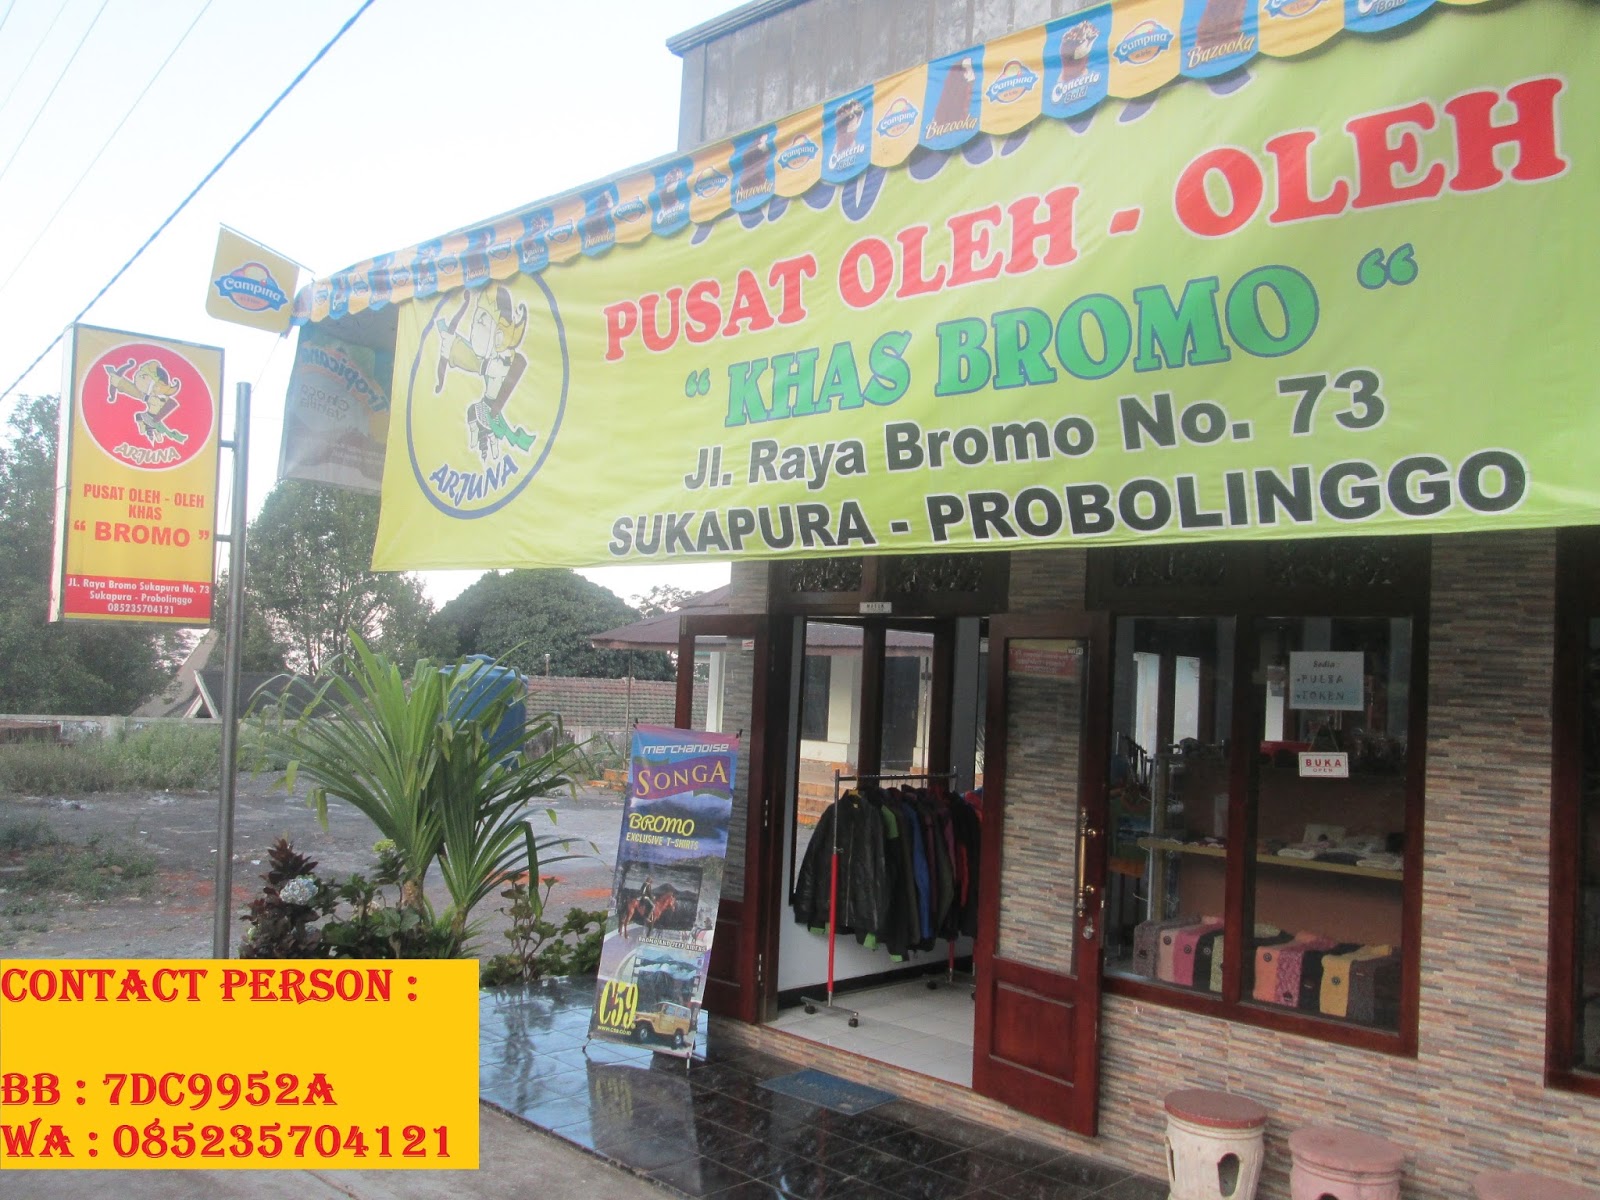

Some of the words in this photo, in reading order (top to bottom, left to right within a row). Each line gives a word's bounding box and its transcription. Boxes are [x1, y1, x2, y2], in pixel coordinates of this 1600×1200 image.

[1119, 33, 1168, 55] Campina
[1186, 32, 1256, 69] Bazooka
[990, 76, 1033, 95] Campina
[1051, 72, 1100, 102] Concerto
[879, 111, 917, 130] Campina
[924, 115, 979, 140] Bazooka
[603, 253, 817, 361] PUSAT
[838, 186, 1079, 309] OLEH
[1175, 77, 1568, 237] OLEH
[222, 277, 282, 302] Campina
[724, 330, 913, 427] KHAS
[934, 264, 1320, 397] BROMO
[684, 444, 733, 490] Jl.
[748, 438, 867, 490] Raya
[884, 416, 1095, 472] Bromo
[1119, 392, 1252, 450] No.
[1278, 369, 1385, 434] 73
[113, 441, 182, 465] ARJUNA
[428, 453, 519, 507] ARJUNA
[83, 483, 125, 501] PUSAT
[128, 488, 161, 504] OLEH
[174, 492, 205, 508] OLEH
[608, 499, 878, 557] SUKAPURA
[926, 449, 1527, 542] PROBOLINGGO
[128, 504, 162, 520] KHAS
[94, 521, 191, 547] BROMO
[83, 579, 106, 590] Raya
[109, 580, 137, 590] Bromo
[140, 581, 180, 593] Sukapura
[182, 583, 197, 593] No.
[199, 585, 210, 594] 73
[90, 590, 132, 602] Sukapura
[141, 593, 193, 606] Probolinggo
[107, 602, 174, 615] 085235704121
[1305, 759, 1342, 767] BUKA
[636, 760, 729, 796] SONGA
[628, 812, 695, 837] BROMO
[626, 831, 663, 846] EXCLUSIVE
[666, 837, 700, 850] T-SHIRTS
[600, 979, 639, 1030] C59
